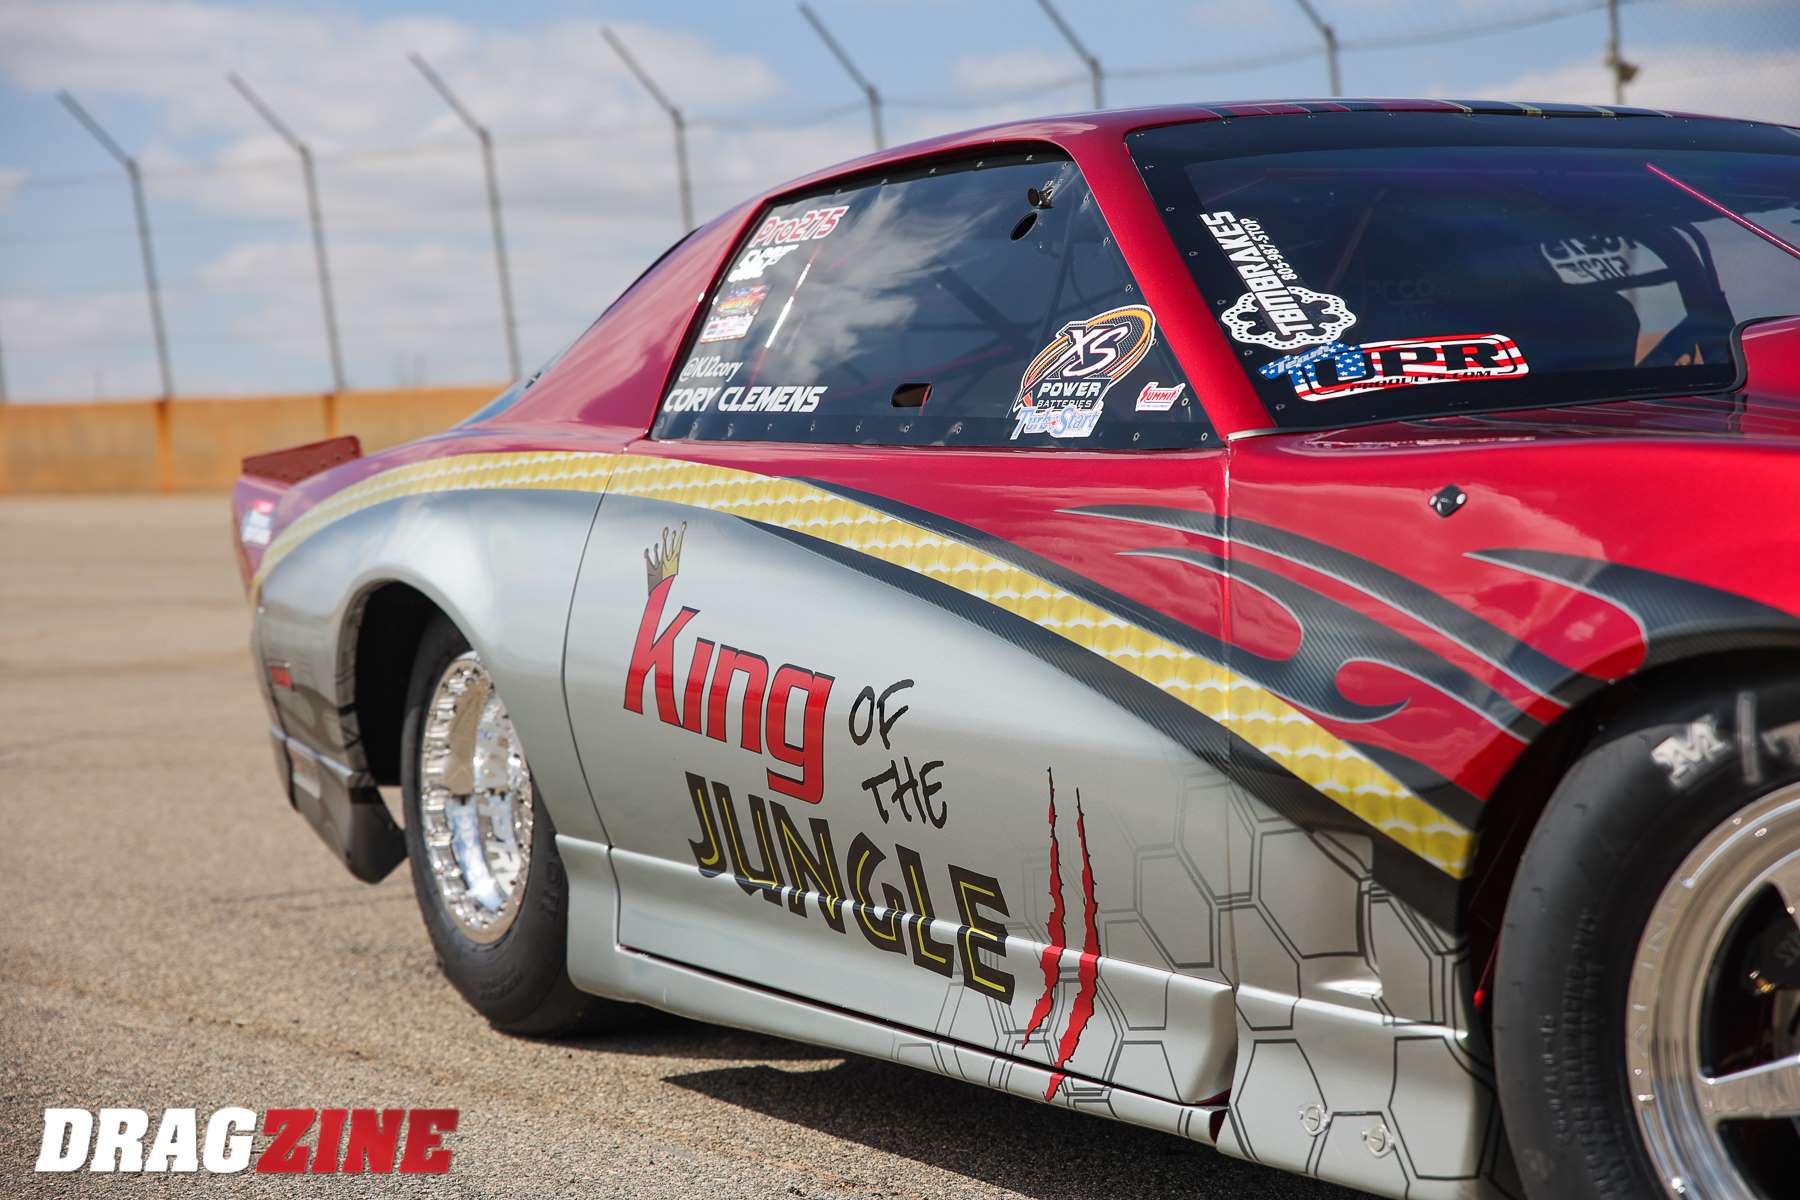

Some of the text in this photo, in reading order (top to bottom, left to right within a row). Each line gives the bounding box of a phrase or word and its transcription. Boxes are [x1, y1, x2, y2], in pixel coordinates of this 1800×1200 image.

[749, 206, 849, 248] Pro275
[1240, 217, 1298, 281] 805-987-STOP
[1042, 325, 1130, 377] XS
[663, 386, 828, 413] CORY CLEMENS
[1036, 400, 1093, 409] BATTERIES
[1037, 382, 1102, 398] POWER
[623, 575, 915, 804] King OF
[861, 759, 949, 829] THE
[684, 770, 1016, 1006] JUNGLE
